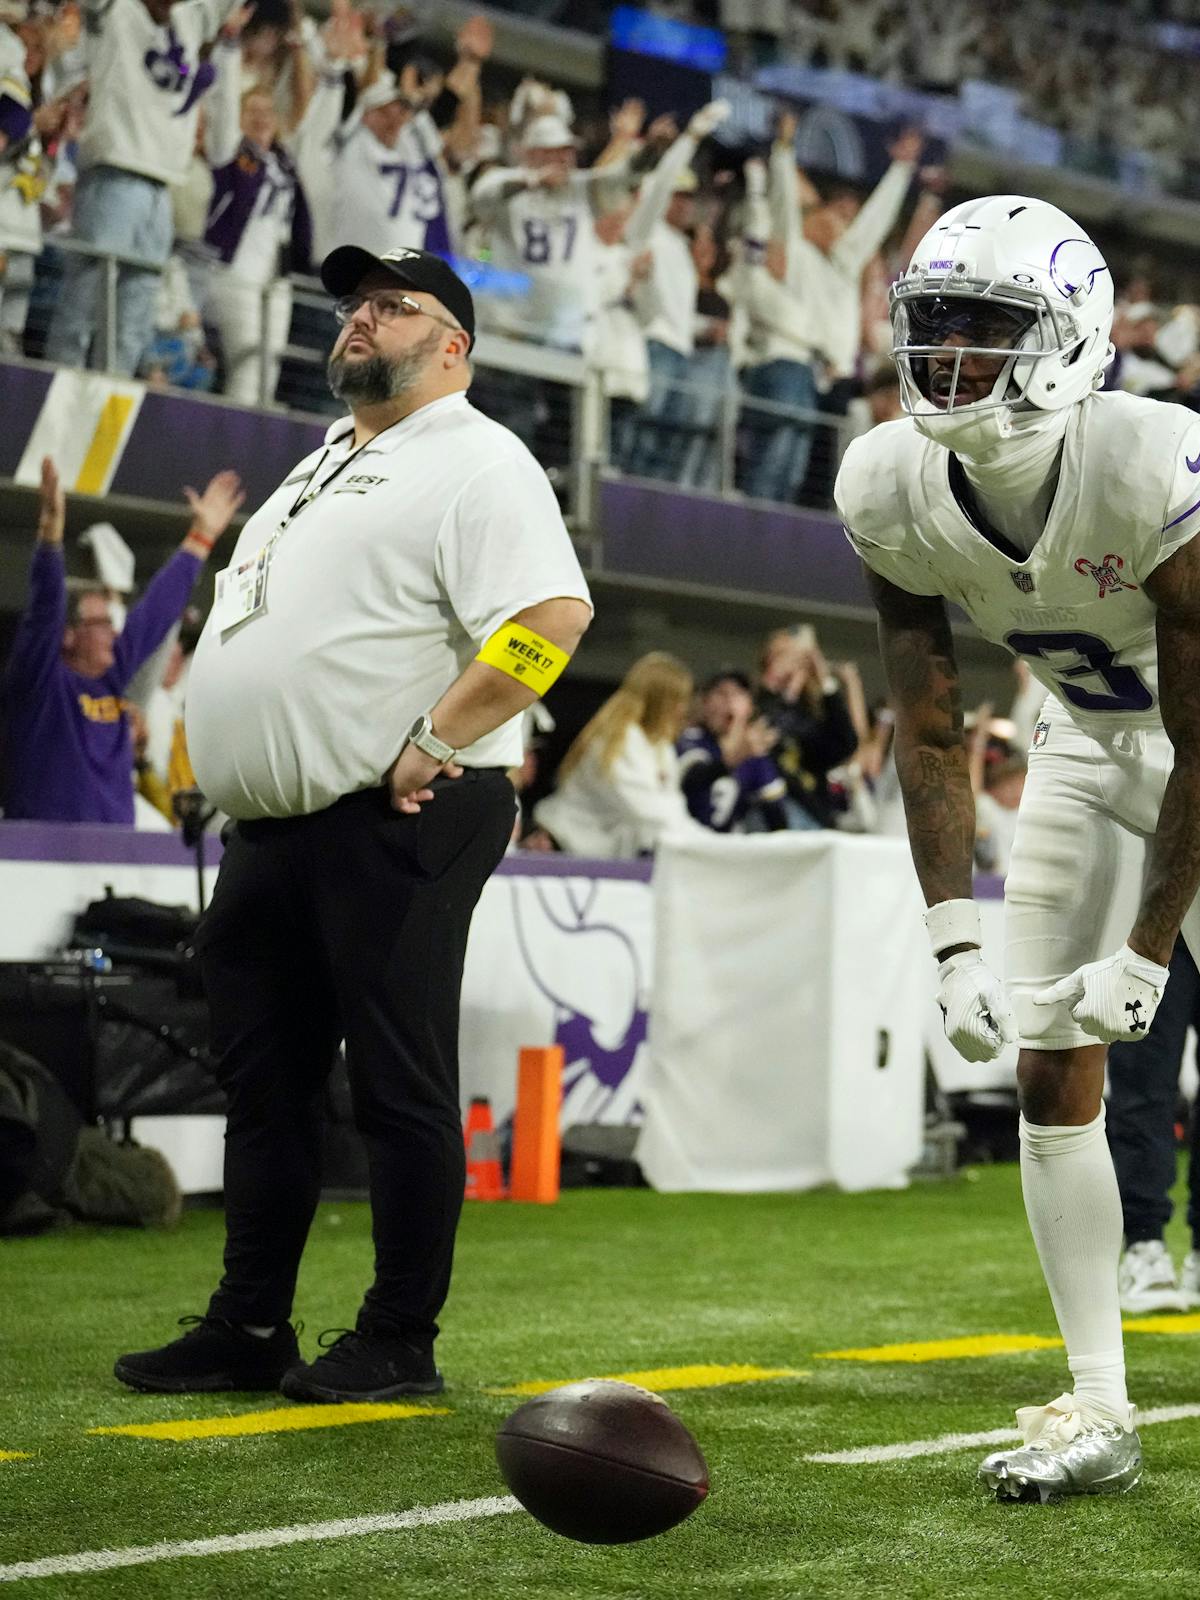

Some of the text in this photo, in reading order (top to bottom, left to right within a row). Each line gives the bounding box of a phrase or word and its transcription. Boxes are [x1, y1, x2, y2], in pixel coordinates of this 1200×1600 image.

[523, 217, 577, 263] 87
[929, 260, 954, 270] VIKINGS
[1009, 606, 1079, 626] VIKINGS
[507, 637, 543, 663] WEEK
[541, 657, 554, 669] 17
[1004, 630, 1156, 713] 3
